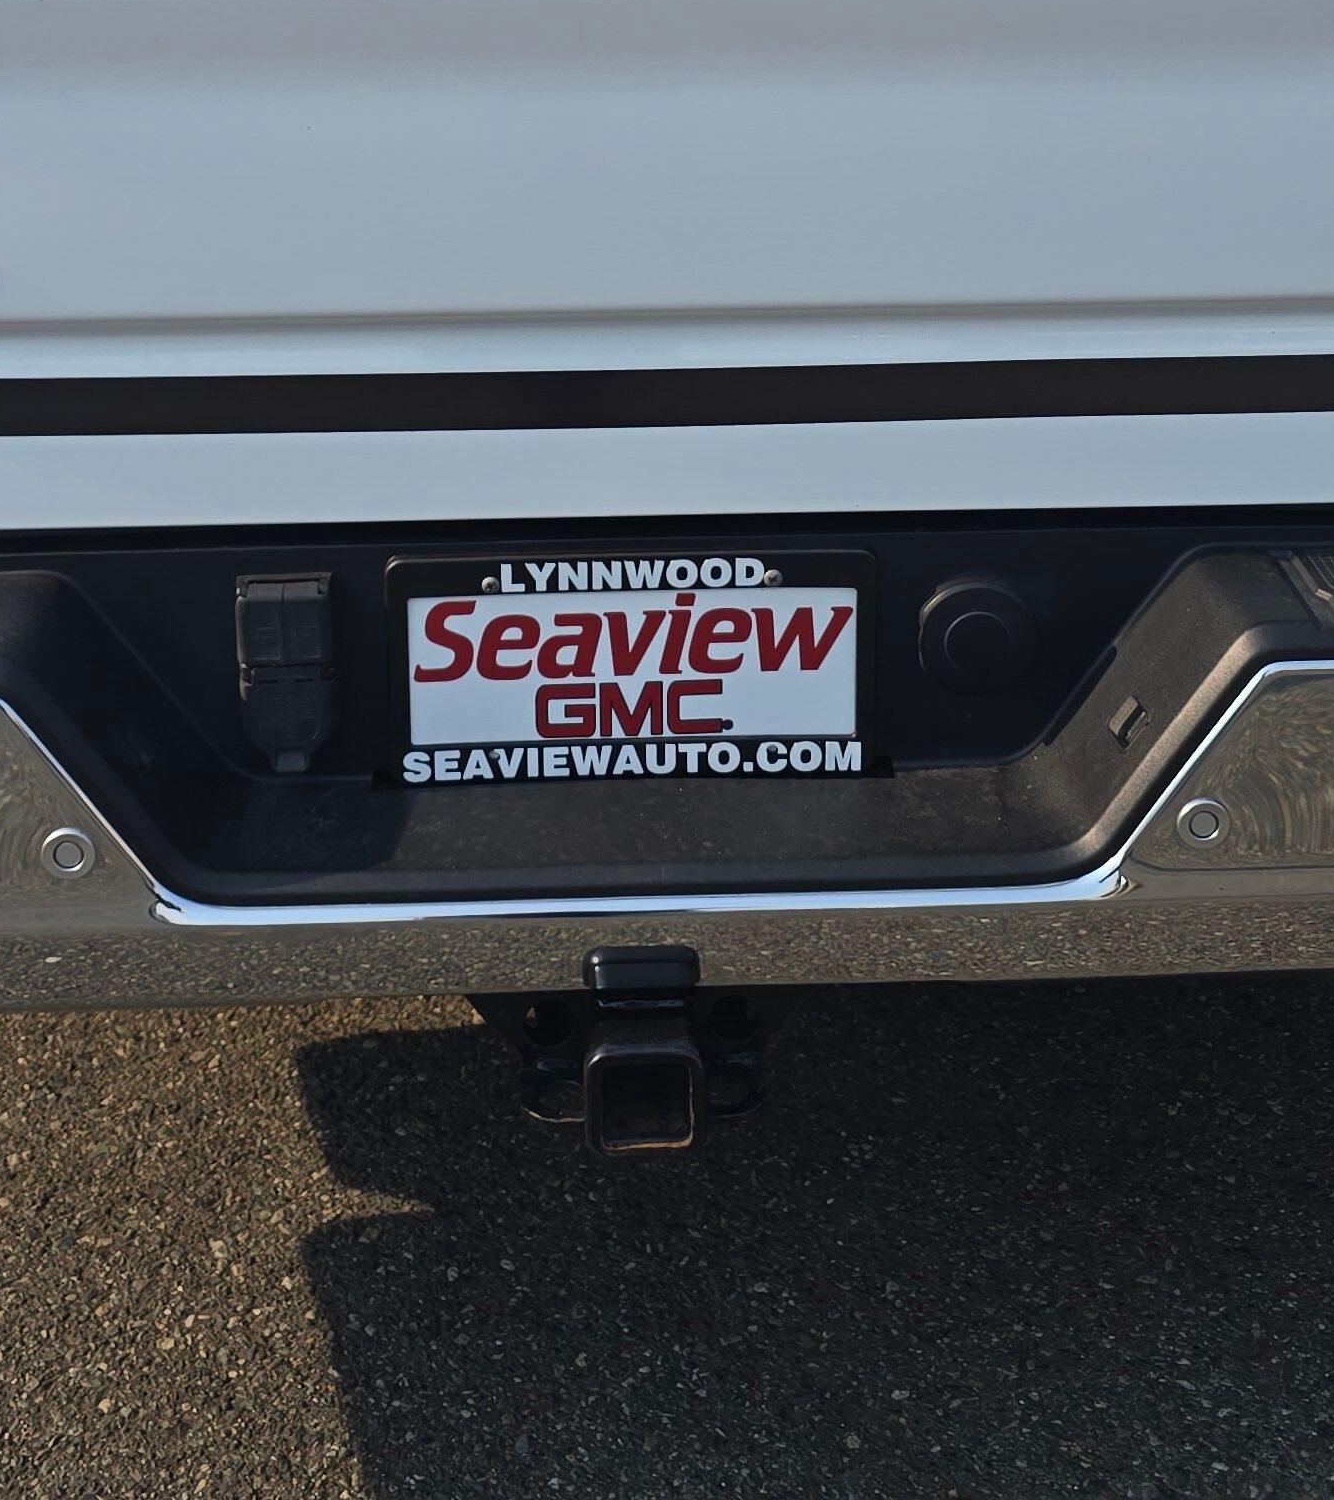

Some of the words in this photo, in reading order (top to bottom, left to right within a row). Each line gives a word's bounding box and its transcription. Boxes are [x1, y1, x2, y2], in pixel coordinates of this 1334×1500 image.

[500, 558, 765, 592] LYNNWOOD
[414, 593, 853, 682] Seaview
[535, 679, 729, 738] GMC
[403, 742, 862, 783] SEAVIEWAUTO.COM
